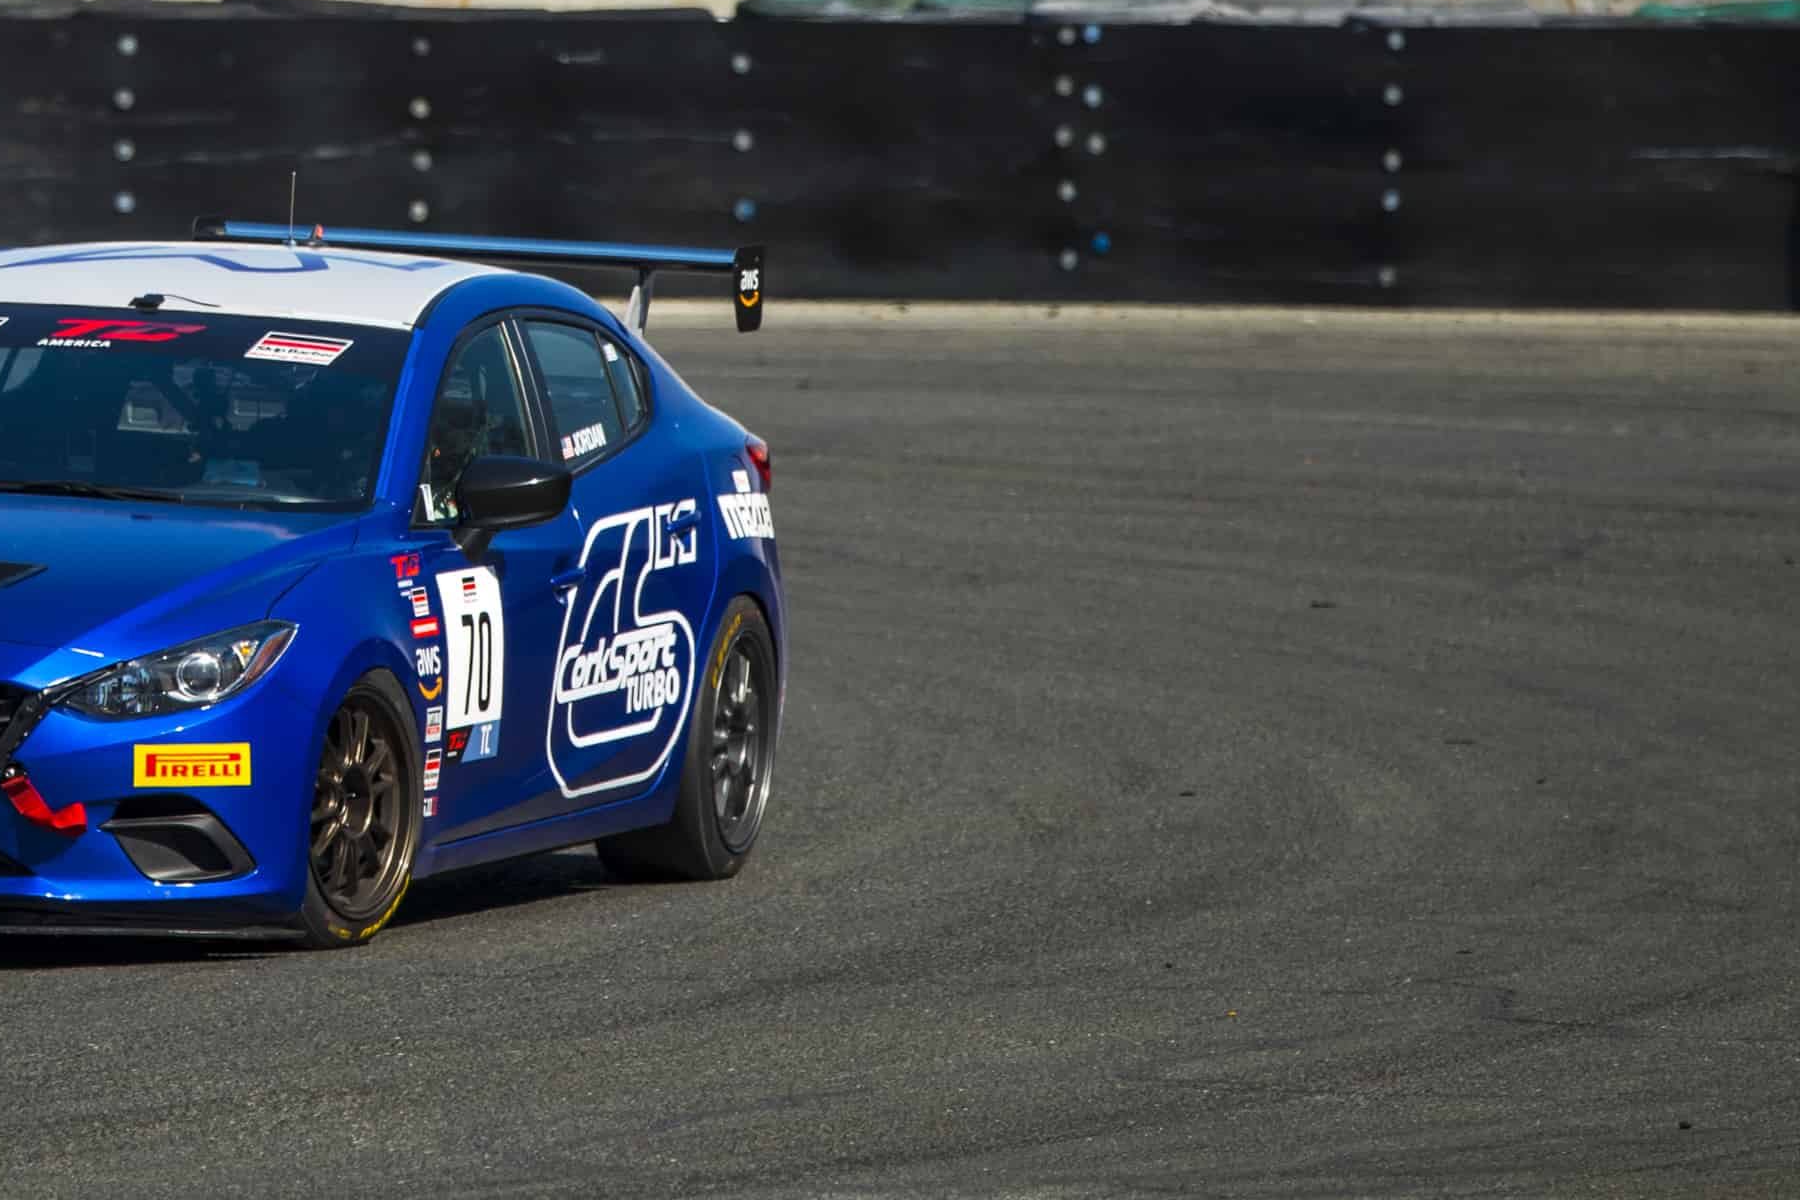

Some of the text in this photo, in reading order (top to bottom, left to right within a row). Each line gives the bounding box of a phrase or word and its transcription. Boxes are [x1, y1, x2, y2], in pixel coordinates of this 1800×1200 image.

[36, 338, 112, 348] AMERICA
[416, 646, 442, 677] aws
[461, 611, 492, 716] 70
[625, 667, 680, 714] TURBO
[145, 753, 241, 777] PIRELLI
